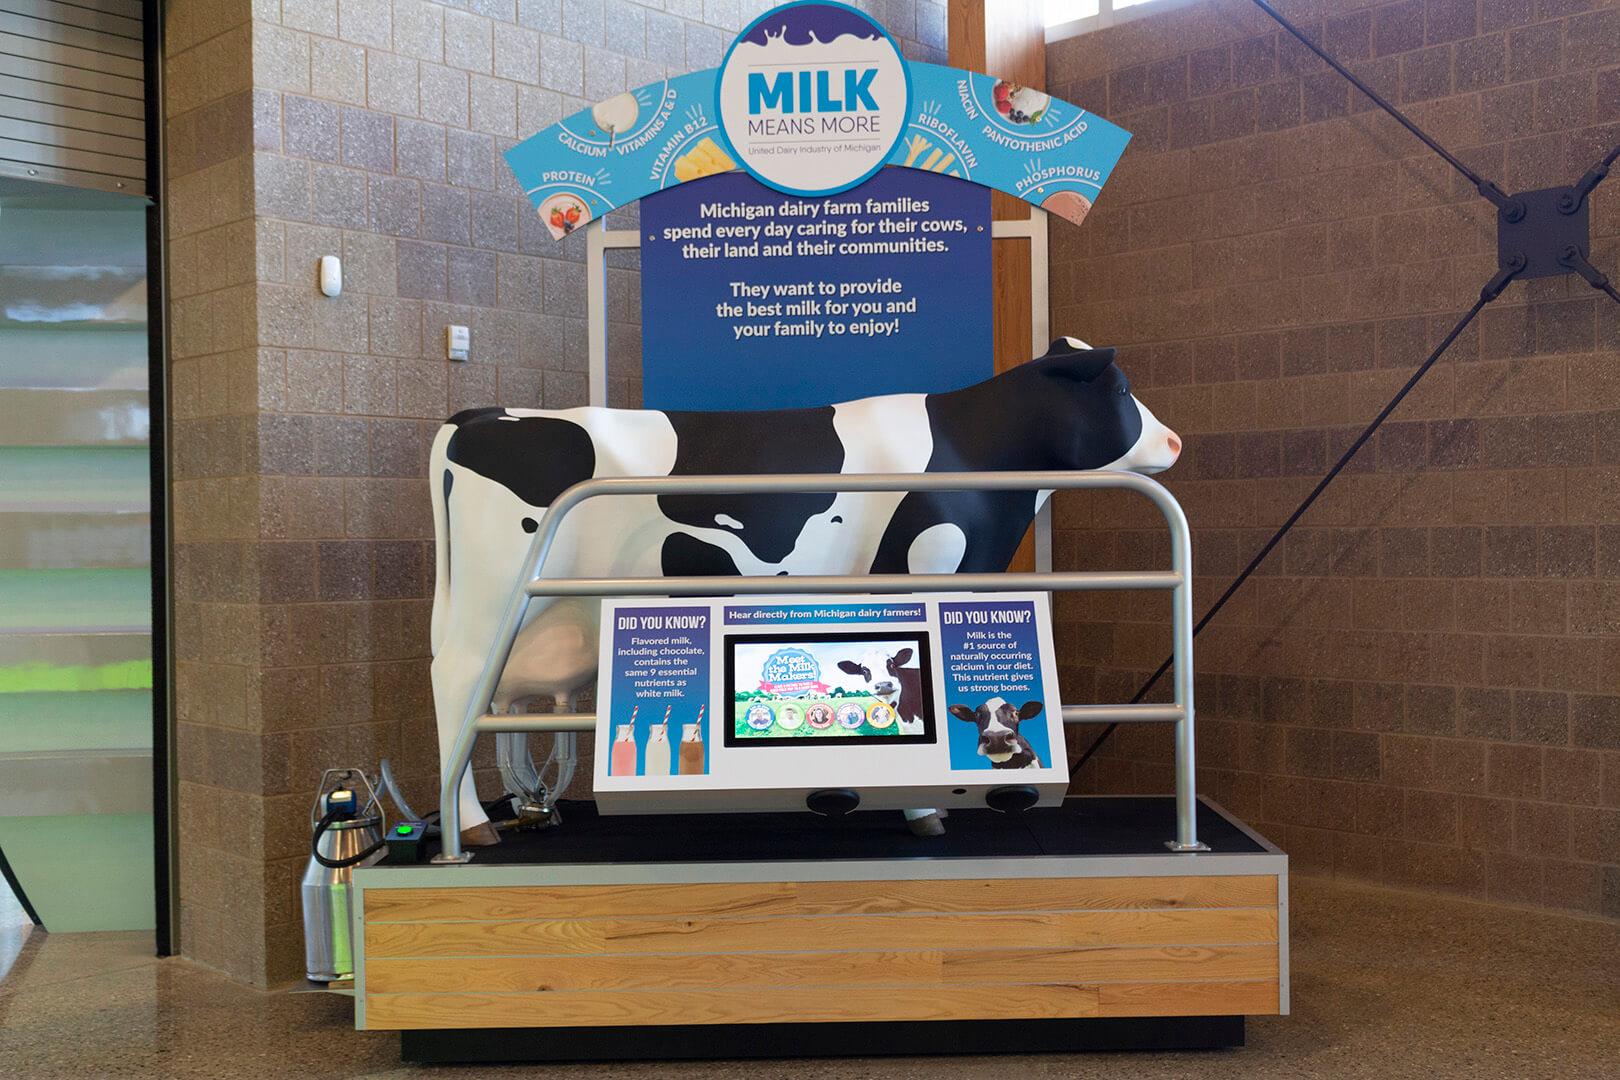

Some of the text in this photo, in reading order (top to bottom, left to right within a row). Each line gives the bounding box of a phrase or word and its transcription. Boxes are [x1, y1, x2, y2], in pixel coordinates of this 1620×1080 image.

[748, 68, 880, 115] MILK
[616, 88, 678, 156] VITAMINS A & D
[957, 79, 1089, 152] NIACIN PANTOTHENIC ACID
[748, 115, 880, 136] MEANS MORE
[558, 131, 607, 158] CALCIUM
[918, 113, 978, 169] RIBOFLAVIN
[649, 116, 708, 181] VITAMIN B12
[748, 143, 881, 155] United Dairy Industry of Michigan
[542, 170, 596, 187] PROTEIN
[1015, 166, 1101, 192] PHOSPHORUS
[700, 198, 930, 221] Michigan dairy farm families
[663, 218, 968, 242] spend every day caring for their cows,
[682, 237, 949, 259] their land and their communities.
[730, 278, 902, 299] They want to provide
[715, 297, 916, 318] the best milk for you and
[733, 318, 900, 340] your family to enjoy!
[729, 608, 921, 620] Hear directly from Michigan dairy farmers!
[944, 610, 1031, 624] DID YOU KNOW?
[618, 615, 706, 630] DID YOU KNOW?
[631, 637, 692, 645] Flavored milk,
[967, 631, 1012, 639] Milk is the
[618, 646, 705, 657] including chocolate,
[964, 642, 974, 650] #1
[1008, 641, 1018, 649] of
[634, 657, 688, 666] contains the
[776, 655, 806, 665] Meet
[951, 652, 1032, 662] naturally occurring
[625, 667, 697, 677] same 9 essential
[768, 663, 816, 674] the Milk
[951, 663, 984, 671] calcium
[1014, 662, 1033, 670] diet.
[634, 678, 675, 687] nutrients
[768, 671, 816, 682] Makers!
[952, 673, 1034, 682] This nutrient gives
[636, 689, 685, 698] white milk.
[970, 684, 999, 693] strong
[1001, 683, 1030, 692] bones.
